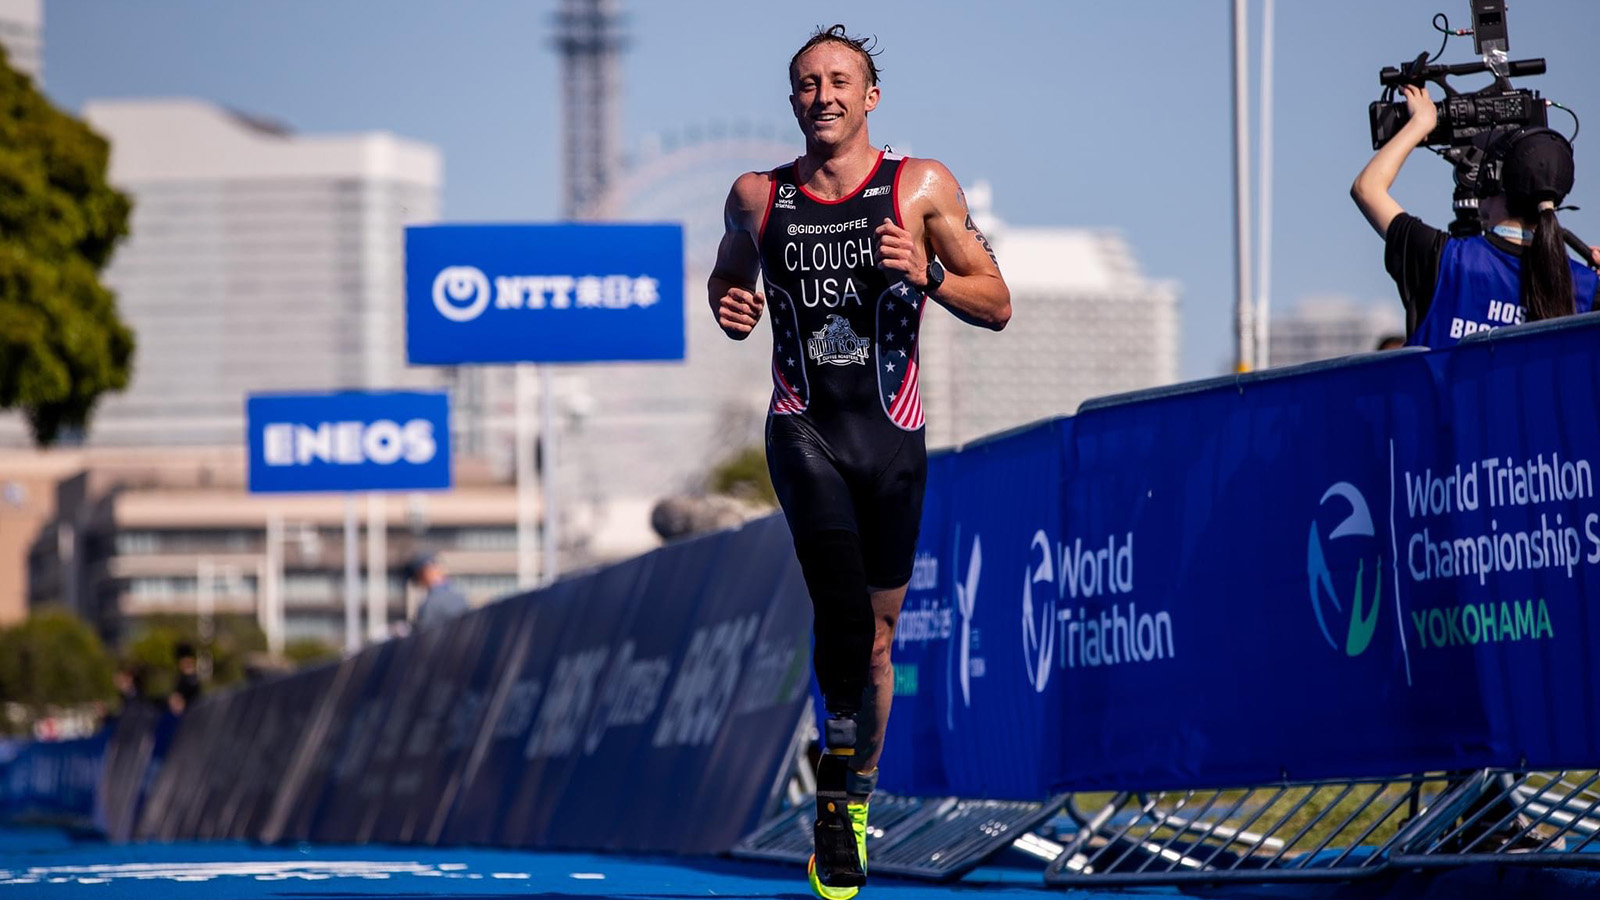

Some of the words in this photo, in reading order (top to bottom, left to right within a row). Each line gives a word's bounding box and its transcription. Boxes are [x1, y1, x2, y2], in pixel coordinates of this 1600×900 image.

[787, 218, 868, 236] @GIDDYCOFFEE
[784, 237, 874, 272] CLOUGH
[801, 277, 862, 308] USA
[1487, 299, 1527, 325] HOS
[263, 419, 436, 466] ENEOS
[1405, 461, 1479, 518] World
[1482, 452, 1593, 508] Triathlon
[1057, 532, 1133, 600] World
[1408, 513, 1580, 586] Championship
[1057, 602, 1175, 669] Triathlon
[1411, 598, 1554, 649] YOKOHAMA
